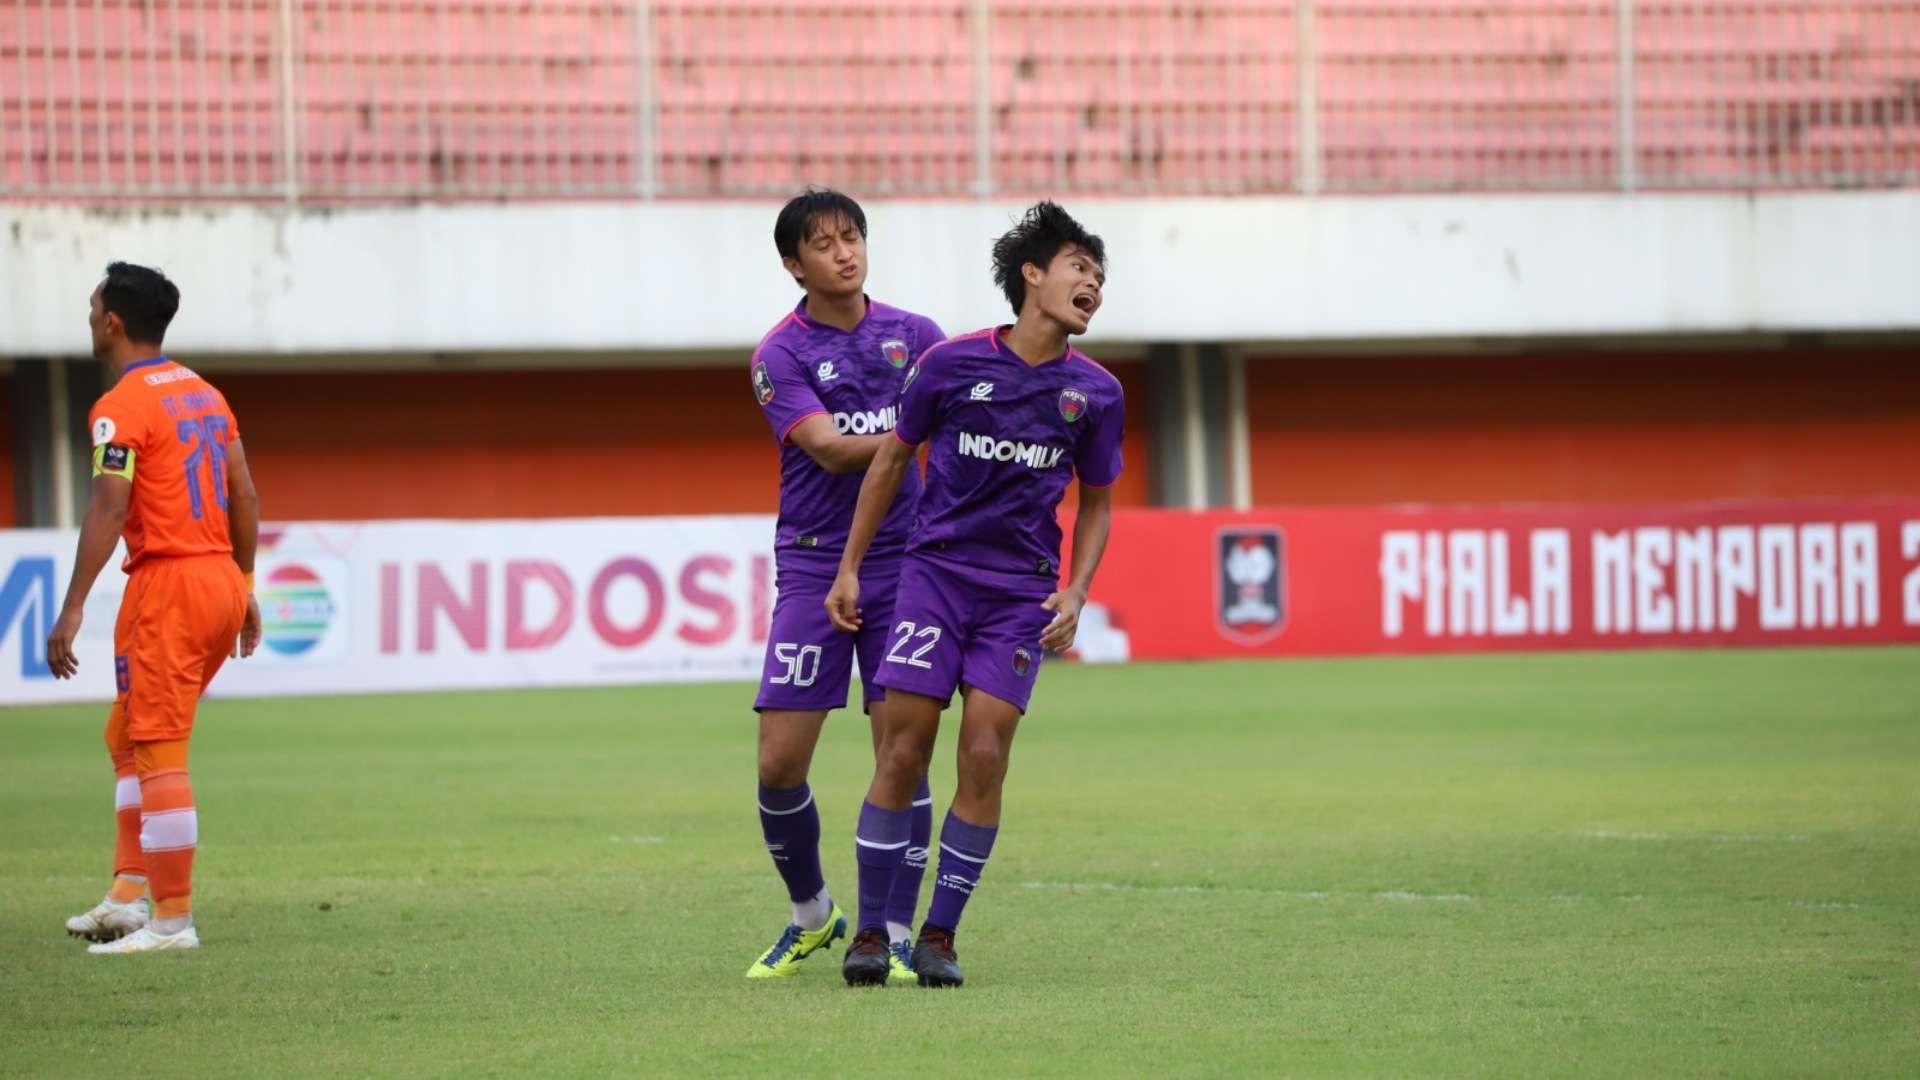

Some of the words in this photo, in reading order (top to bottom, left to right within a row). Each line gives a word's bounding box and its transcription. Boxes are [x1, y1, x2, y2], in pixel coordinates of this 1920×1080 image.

[833, 404, 901, 435] DOMIL
[959, 431, 1065, 469] INDOMILK
[1380, 529, 1571, 637] PIALA
[1592, 521, 1880, 634] MENPORA
[379, 553, 771, 655] INDOSI
[770, 643, 822, 686] 50
[886, 621, 942, 669] 22
